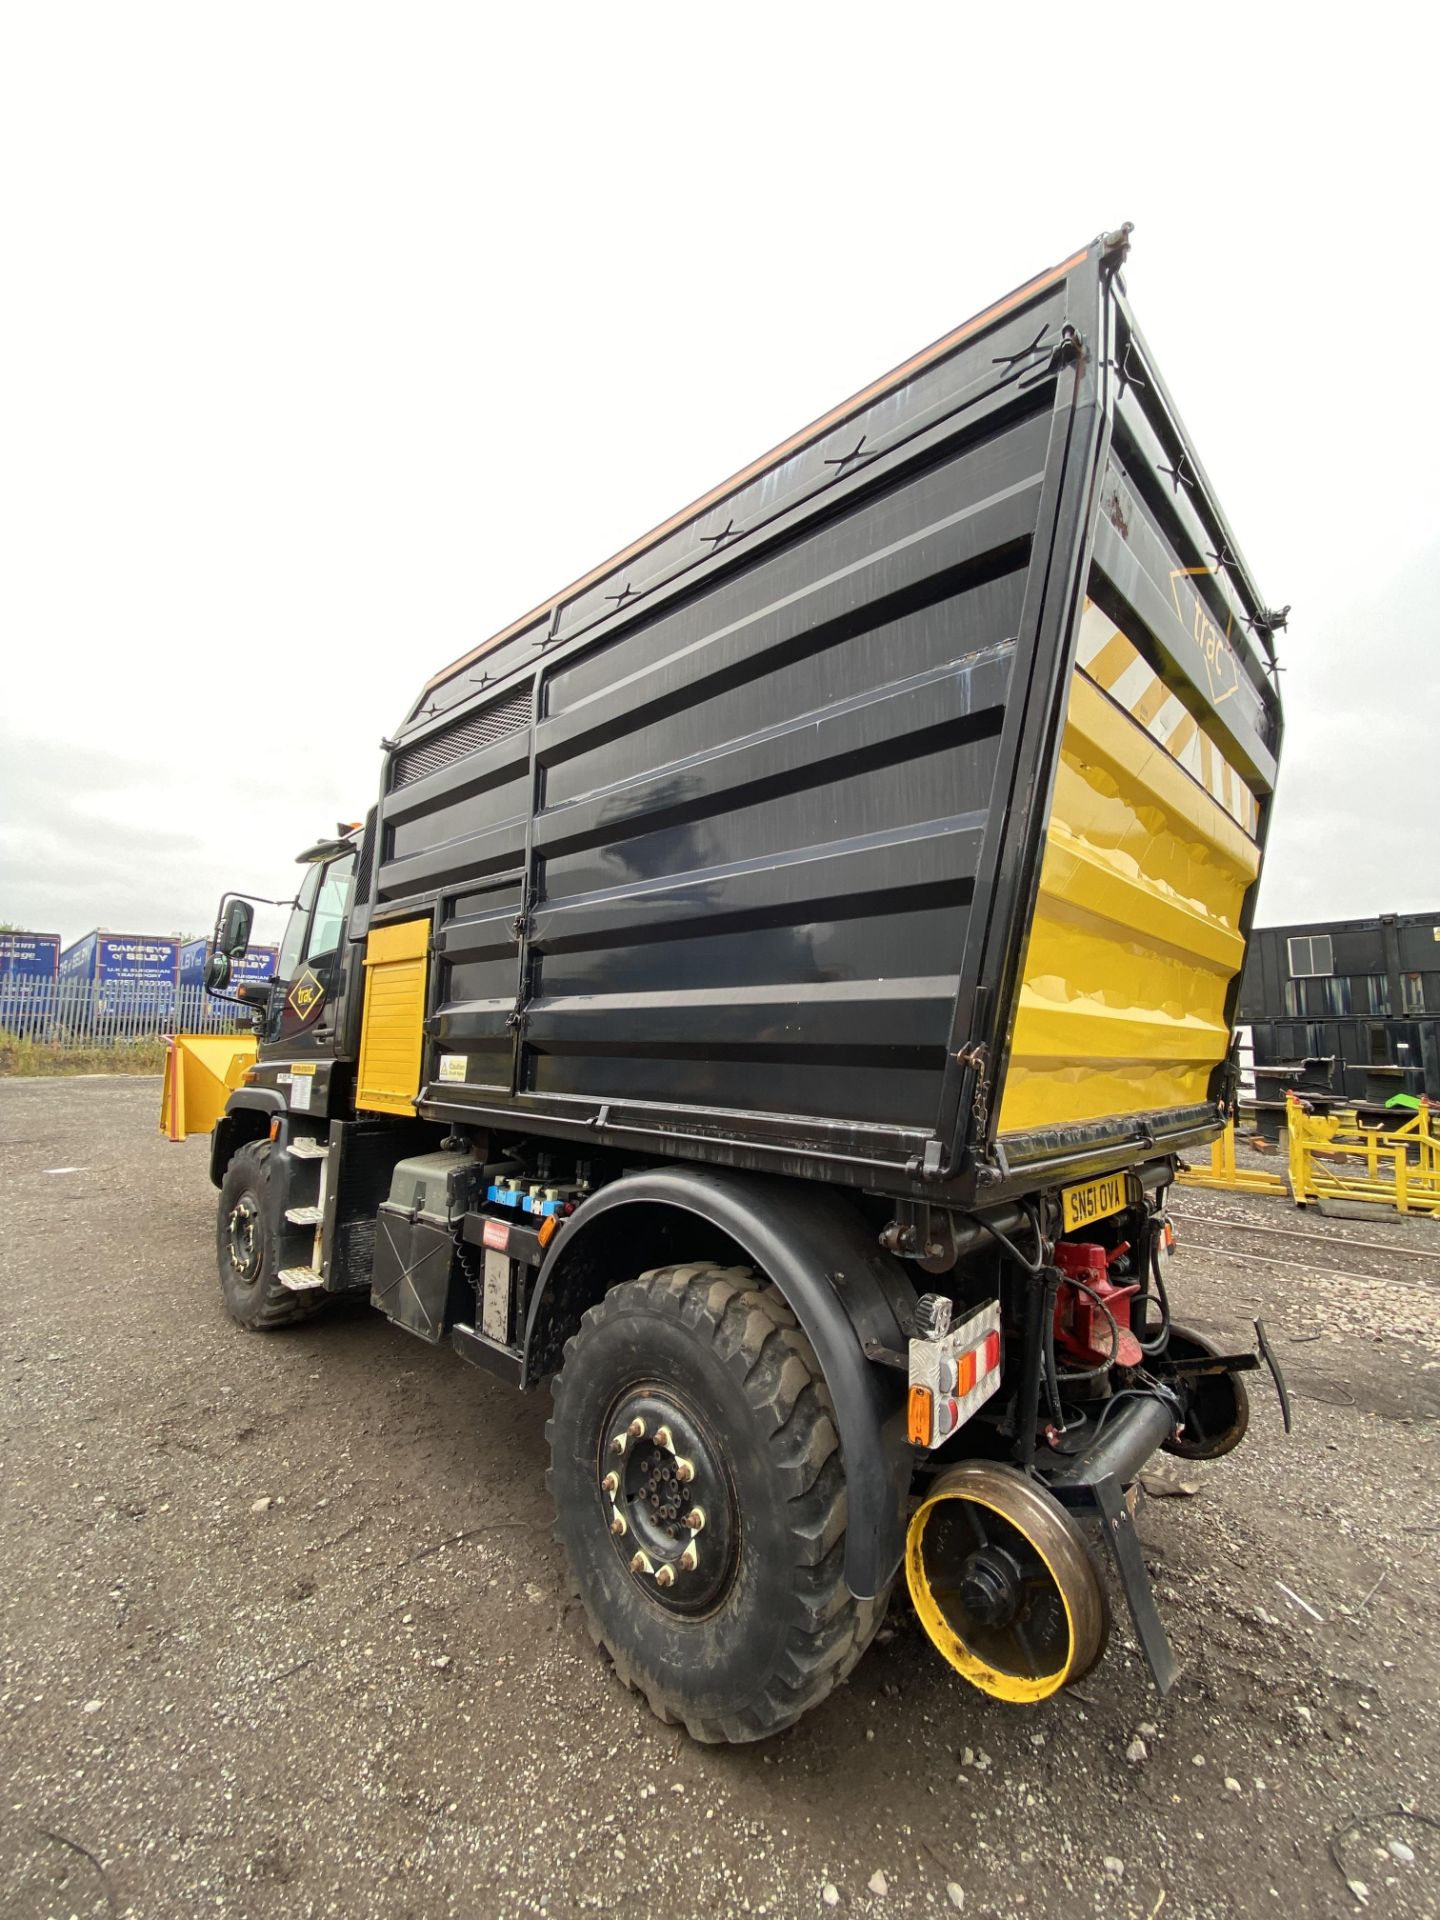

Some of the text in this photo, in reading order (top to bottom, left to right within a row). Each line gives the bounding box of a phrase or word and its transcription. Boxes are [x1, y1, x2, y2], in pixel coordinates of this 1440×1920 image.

[1194, 595, 1223, 676] trac
[298, 987, 313, 1004] trac
[1071, 1179, 1120, 1223] SN51 OVA
